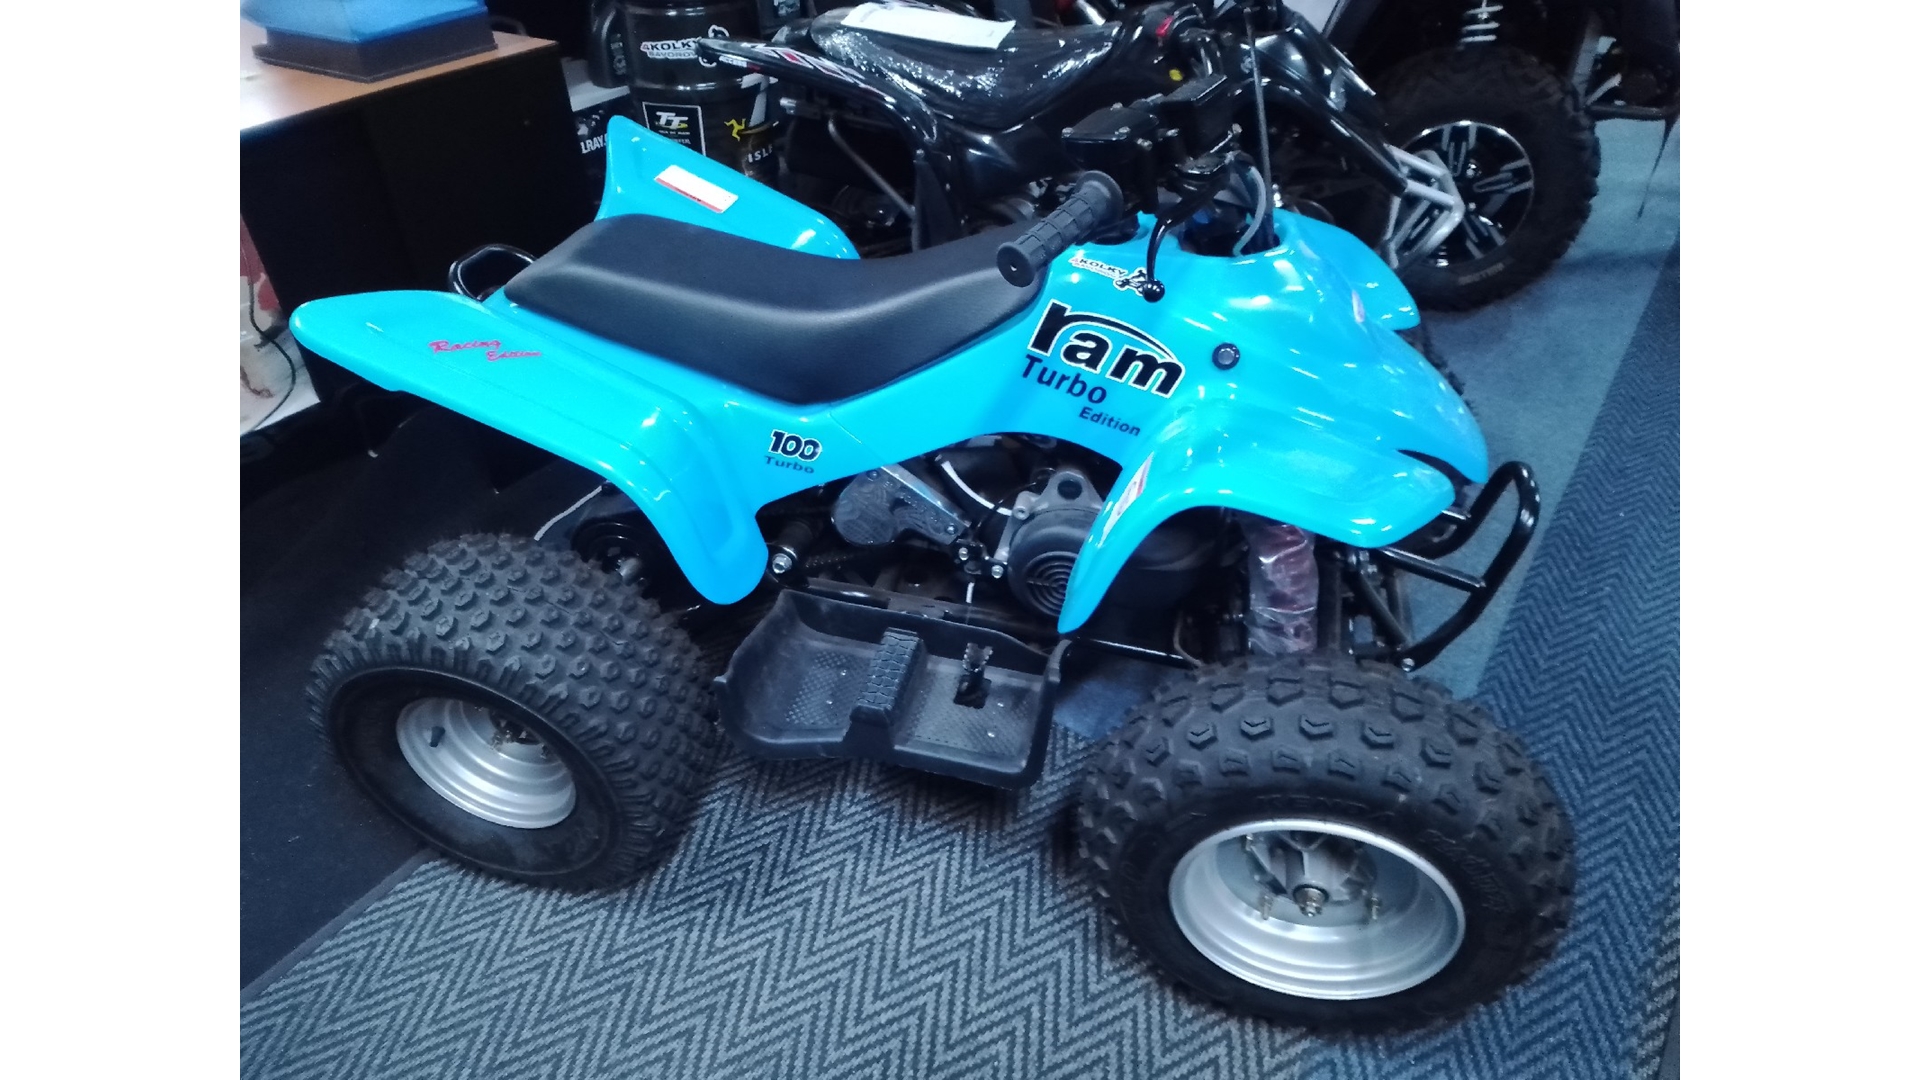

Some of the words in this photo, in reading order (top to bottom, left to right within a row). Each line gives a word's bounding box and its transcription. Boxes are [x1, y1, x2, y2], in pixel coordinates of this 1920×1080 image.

[428, 340, 501, 354] Racing
[1027, 299, 1185, 398] ram
[1022, 354, 1107, 404] Turbo
[1078, 406, 1141, 437] Edition
[768, 429, 823, 462] 100
[764, 455, 815, 474] Turbo
